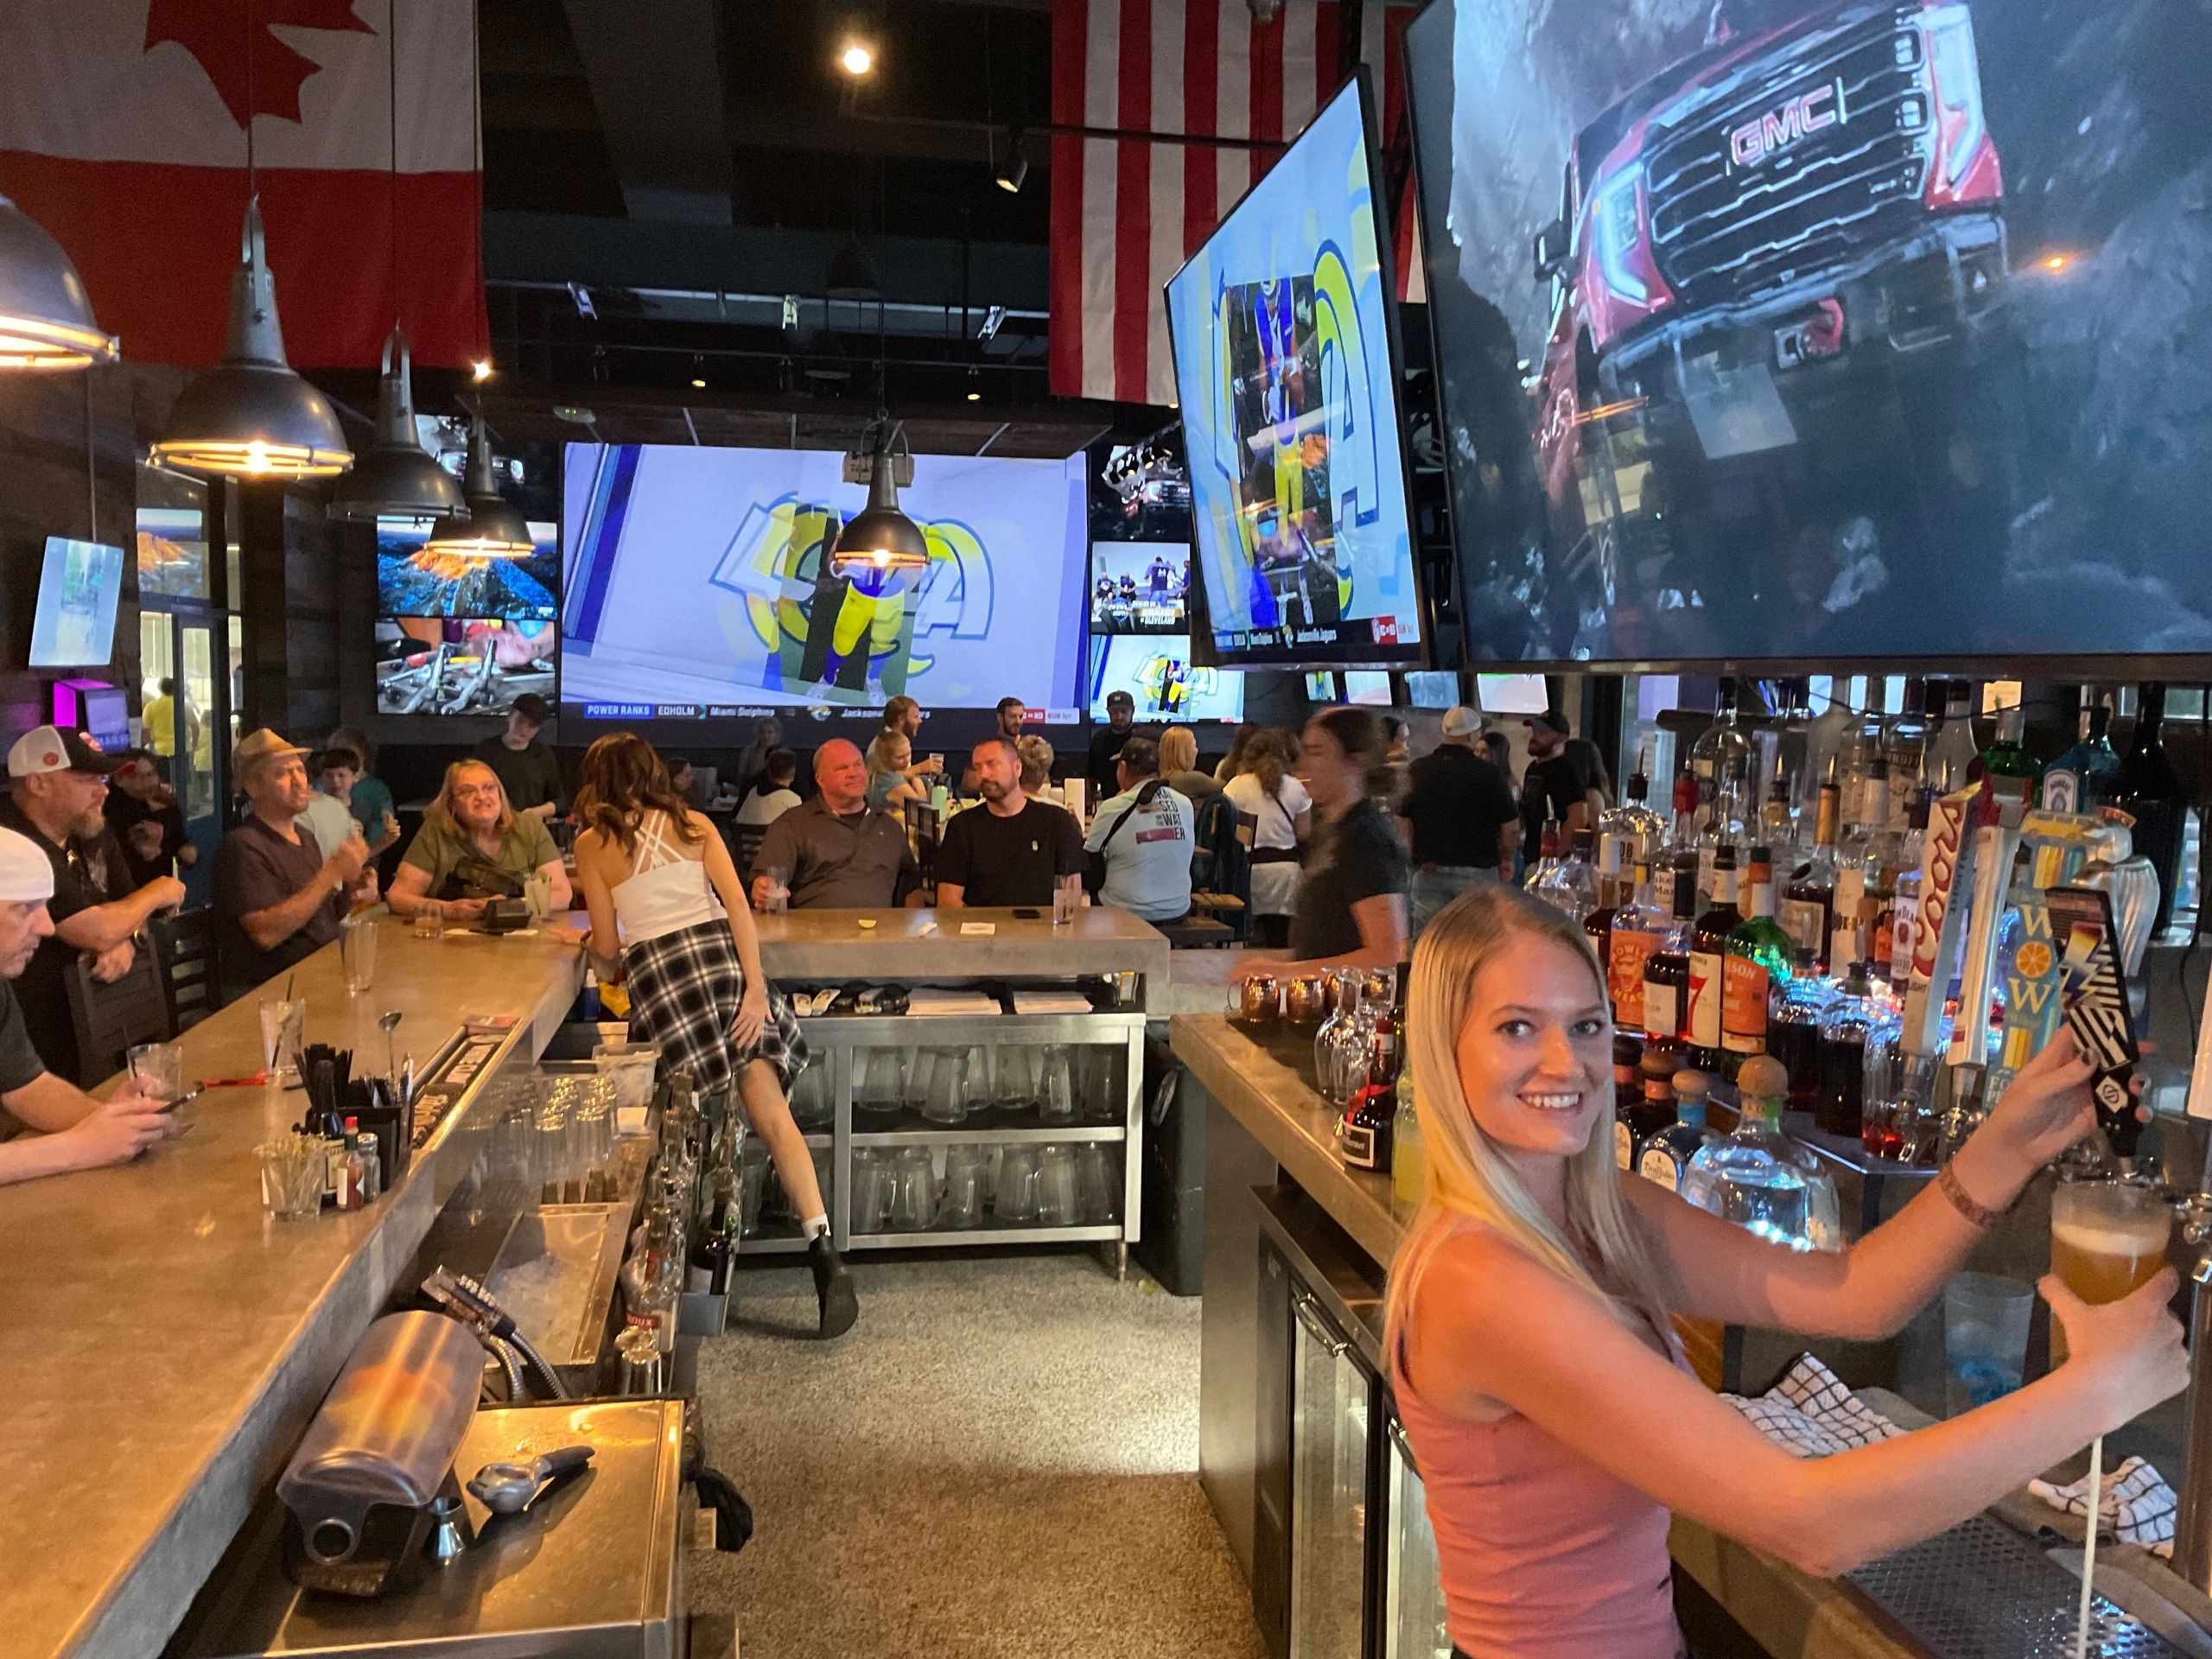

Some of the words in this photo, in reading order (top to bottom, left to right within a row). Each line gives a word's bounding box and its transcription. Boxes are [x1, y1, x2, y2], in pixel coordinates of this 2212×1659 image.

[1731, 84, 1837, 166] GMC
[588, 705, 619, 715] POWER
[620, 705, 650, 715] RANKS
[1159, 800, 1179, 812] SED
[1162, 813, 1182, 826] WAT
[1174, 826, 1185, 841] ER
